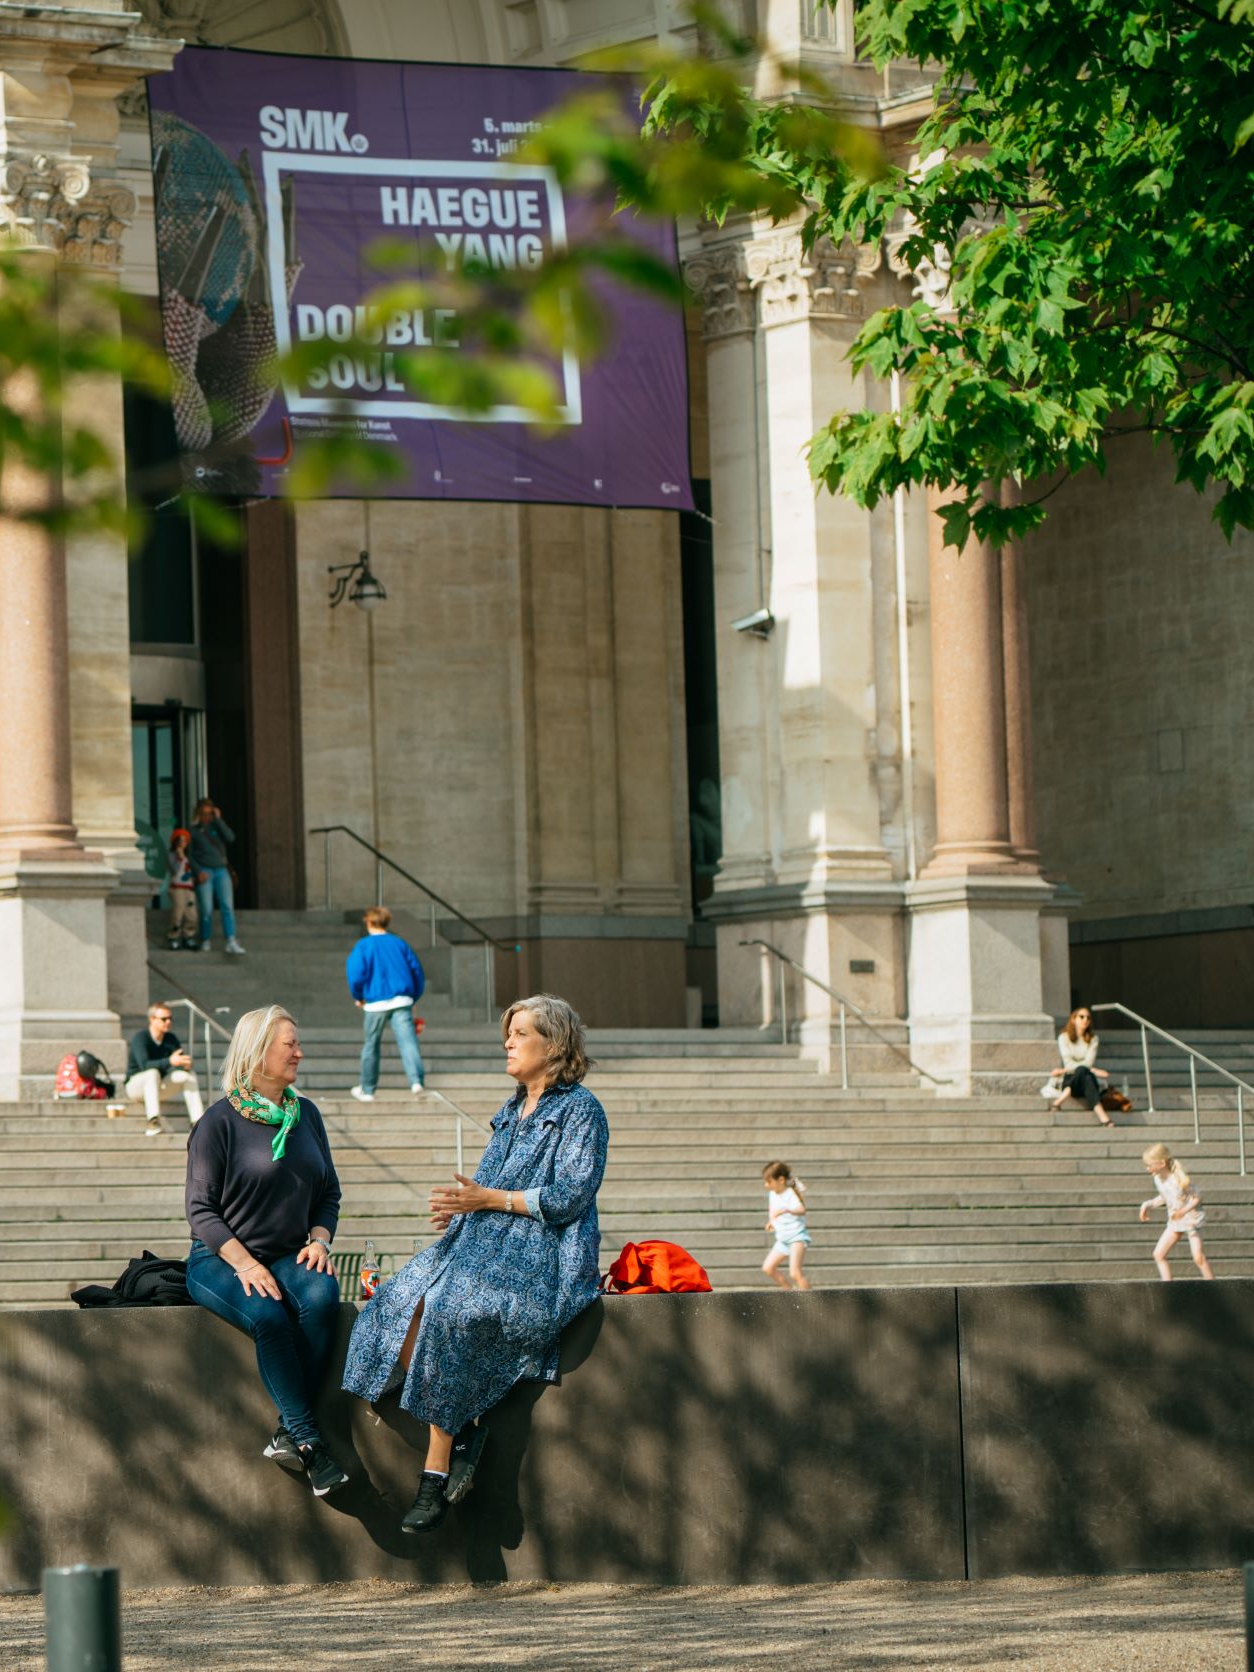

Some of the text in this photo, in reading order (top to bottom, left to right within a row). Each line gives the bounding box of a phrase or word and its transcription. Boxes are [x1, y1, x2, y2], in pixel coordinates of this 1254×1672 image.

[483, 118, 499, 133] 5.
[501, 120, 542, 133] marts
[471, 138, 494, 154] 31.
[496, 139, 518, 157] juli
[380, 186, 542, 229] HAEGUE
[435, 232, 544, 272] YANG
[296, 303, 460, 348] DOUBLE
